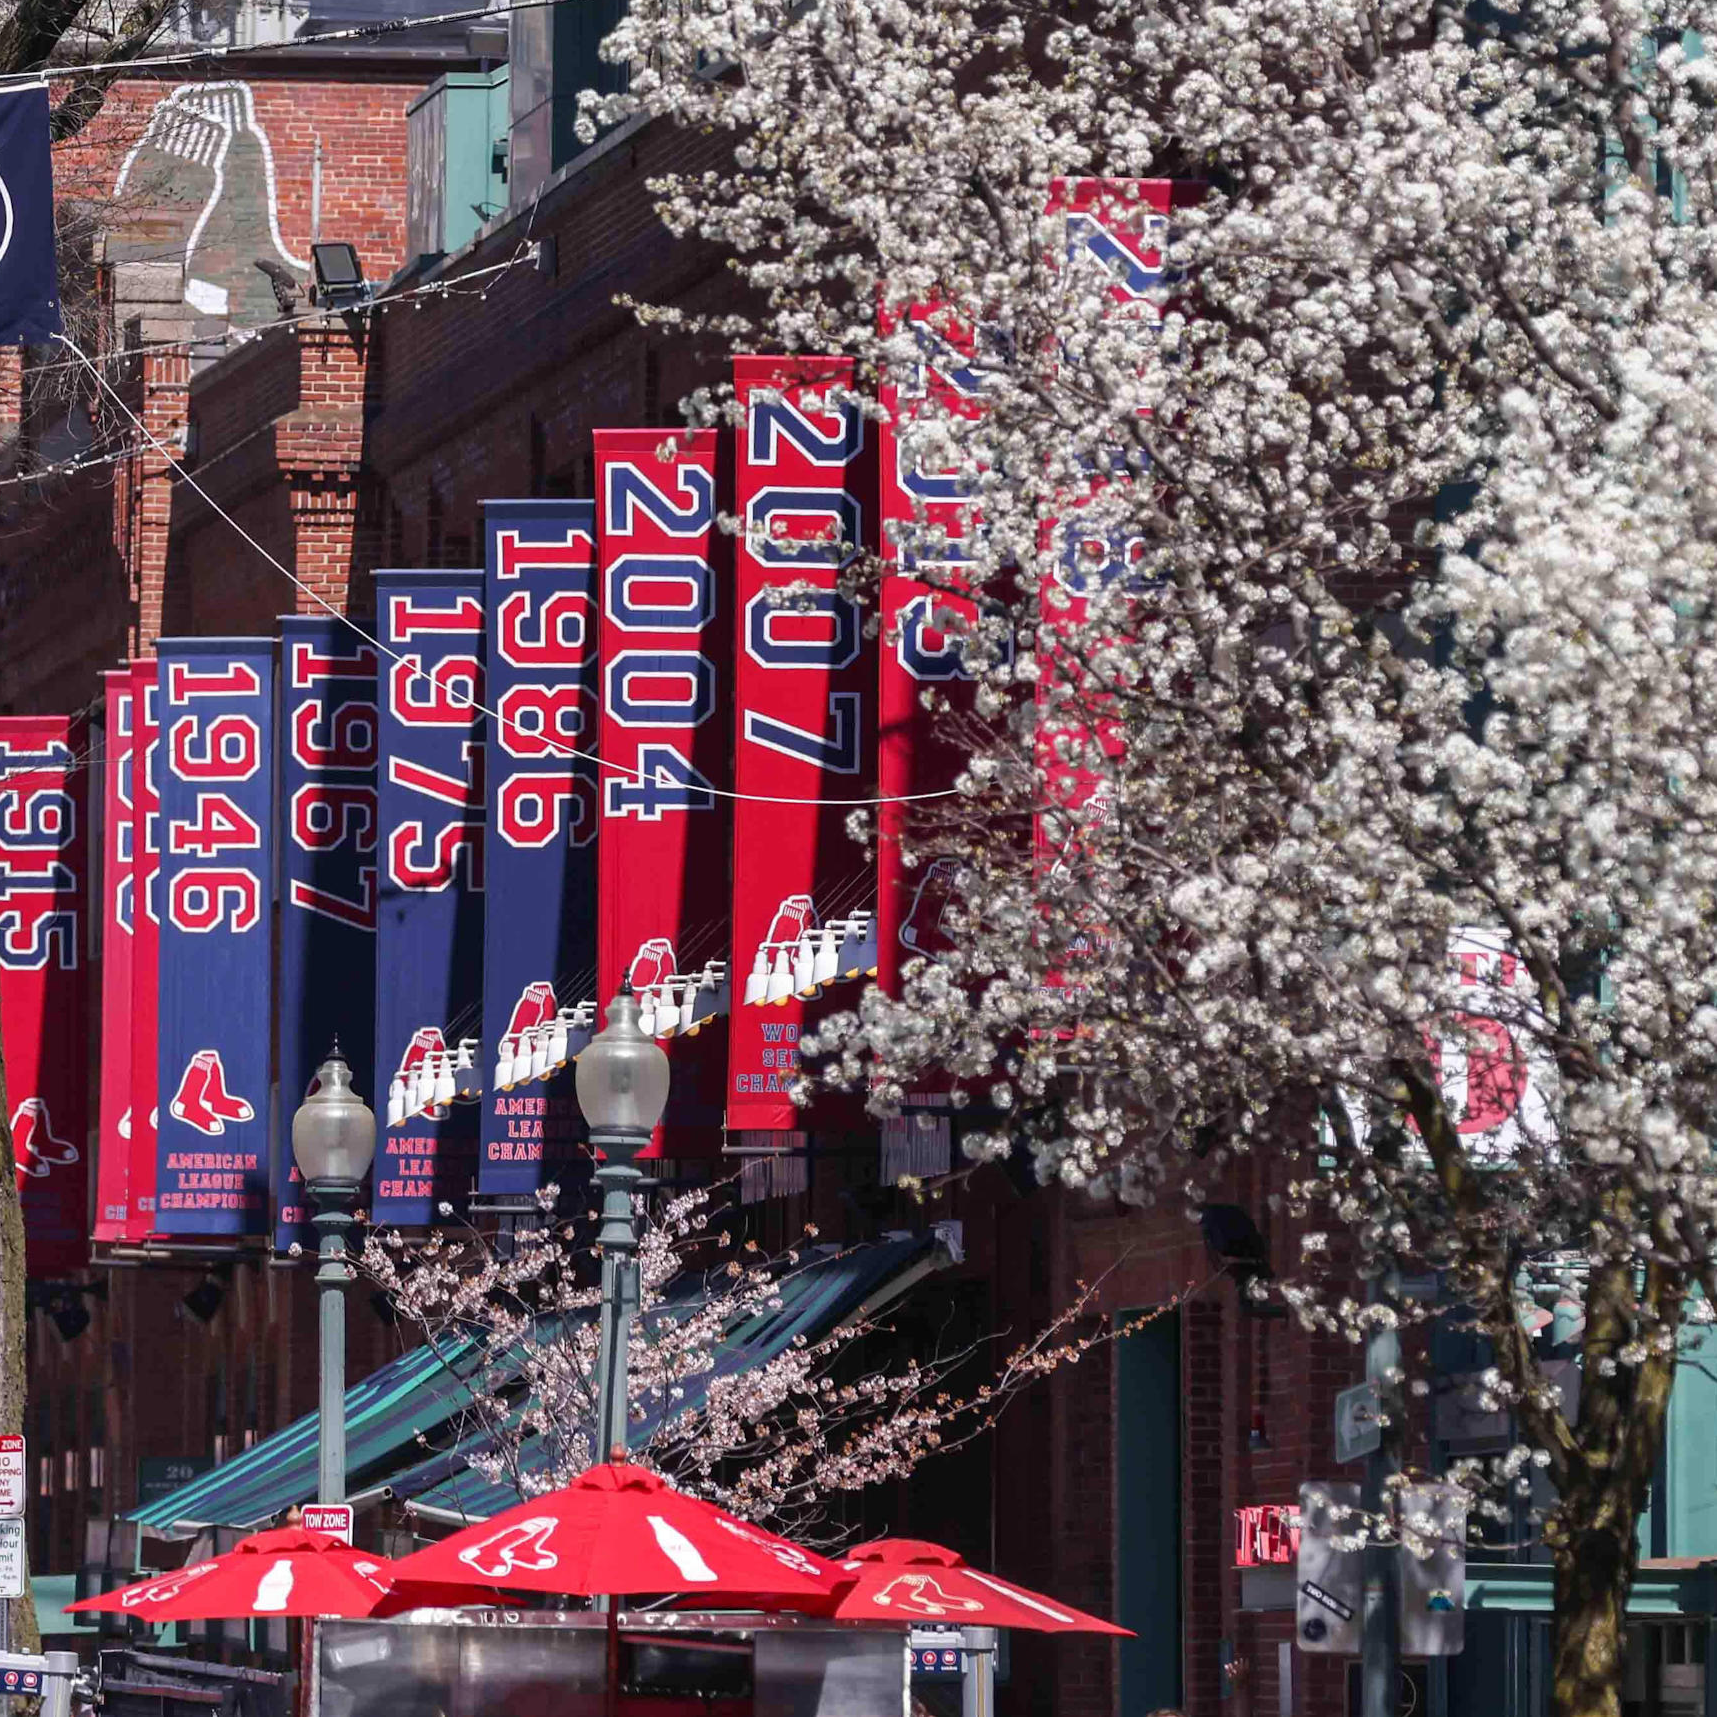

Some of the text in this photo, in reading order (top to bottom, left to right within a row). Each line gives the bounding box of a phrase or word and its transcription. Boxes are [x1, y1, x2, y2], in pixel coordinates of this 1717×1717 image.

[496, 529, 599, 849] 1986
[604, 461, 716, 822] 2004
[744, 389, 864, 775] 2007
[168, 662, 261, 934] 1946
[291, 642, 378, 932] 1967
[388, 595, 487, 893] 1975
[166, 1153, 257, 1169] AMERICAN
[178, 1173, 245, 1189] LEAGUE
[1, 1439, 22, 1450] ZONE
[305, 1513, 347, 1528] TOW ZONE
